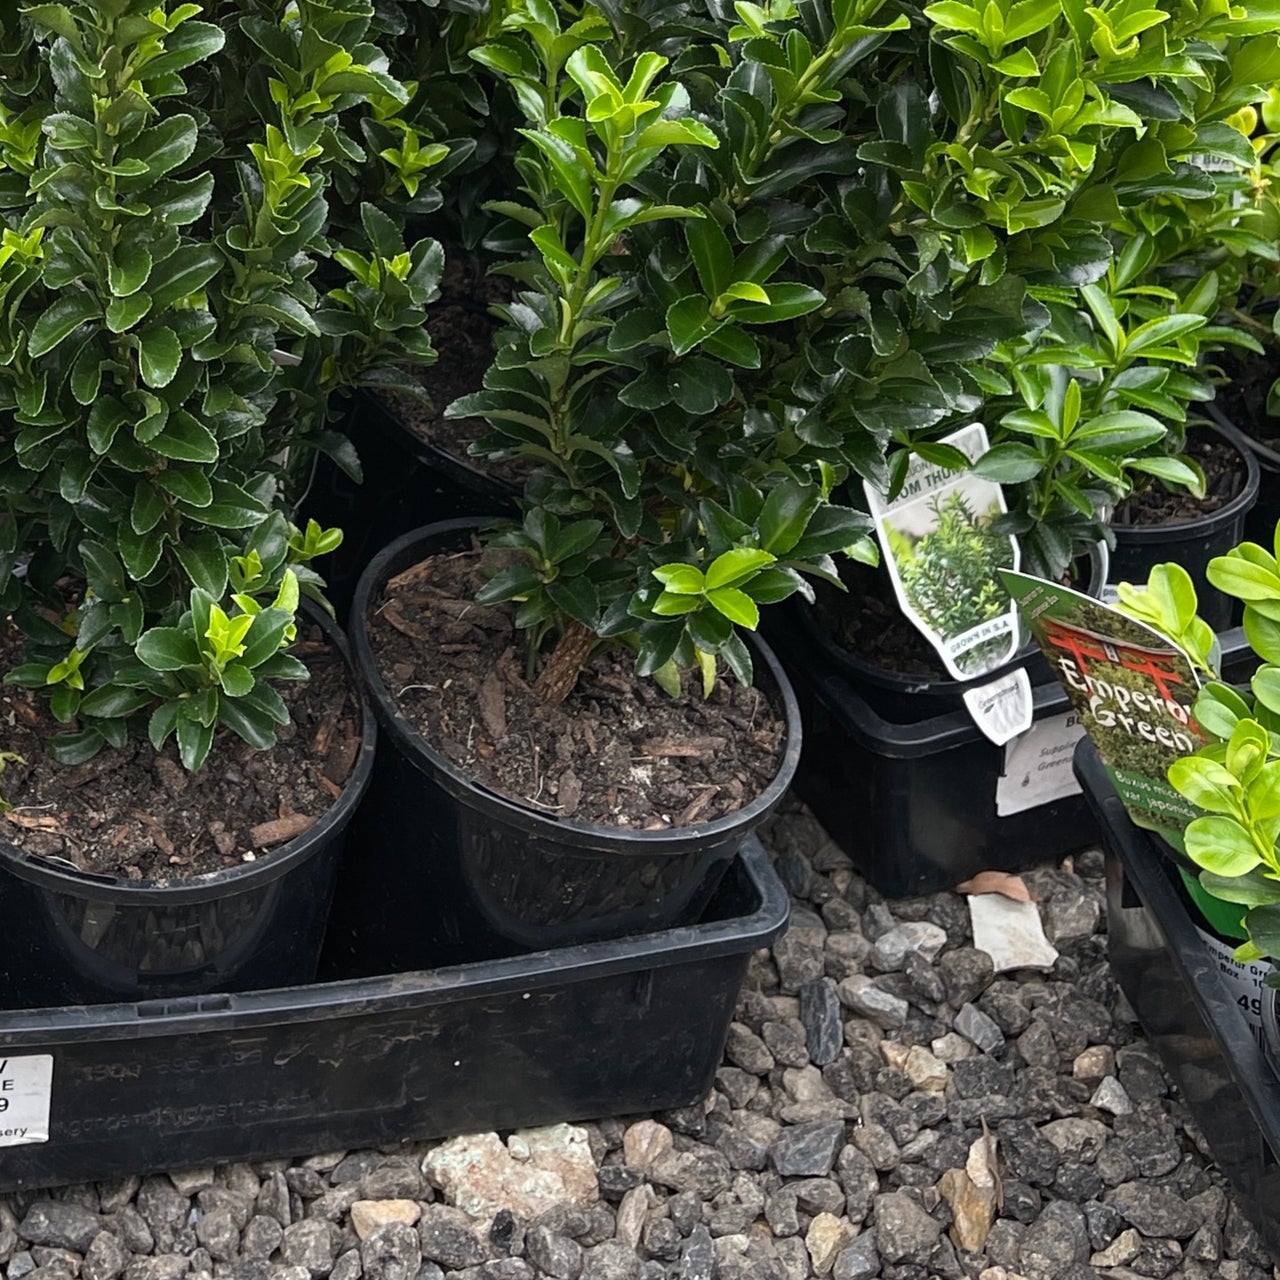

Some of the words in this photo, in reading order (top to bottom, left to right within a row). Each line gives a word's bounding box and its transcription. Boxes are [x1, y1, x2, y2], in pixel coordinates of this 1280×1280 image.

[894, 479, 922, 502] OM
[923, 467, 960, 487] THU
[1089, 695, 1194, 753] Green
[1038, 741, 1078, 758] Supplie
[1147, 797, 1198, 819] japonica
